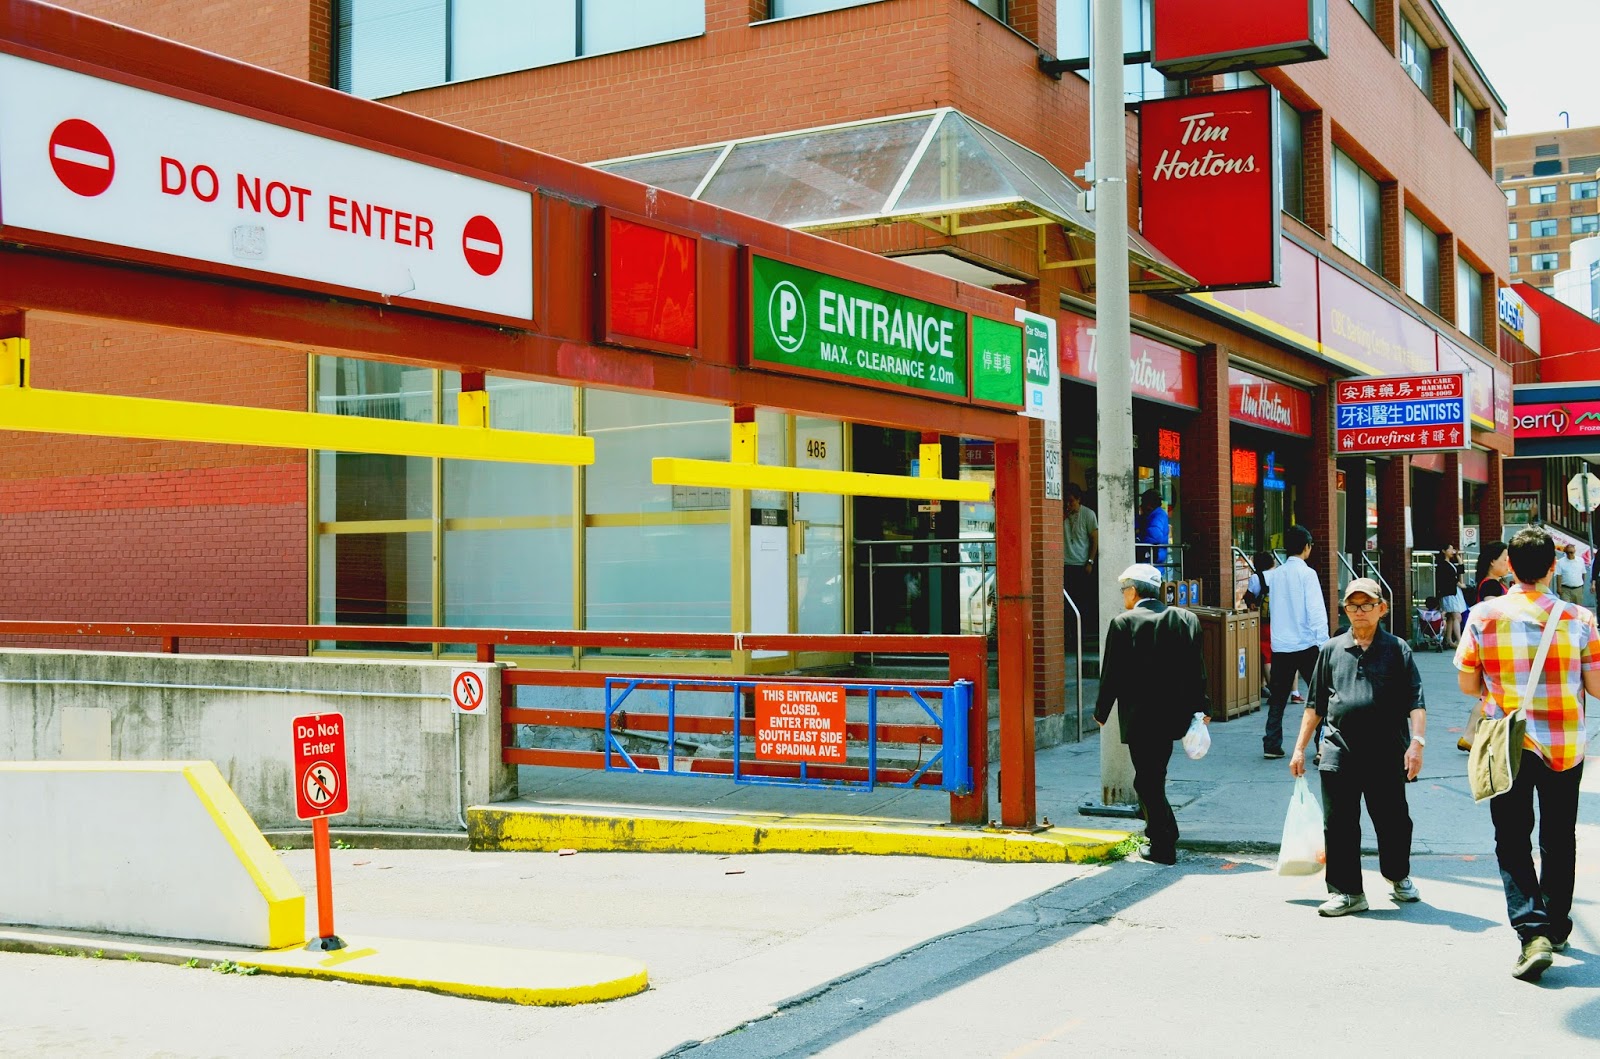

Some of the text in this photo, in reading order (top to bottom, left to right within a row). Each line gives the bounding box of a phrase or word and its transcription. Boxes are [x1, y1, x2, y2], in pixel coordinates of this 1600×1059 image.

[1179, 112, 1231, 146] Tim
[1152, 149, 1256, 182] Hortons
[160, 156, 435, 251] DO NOT ENTER
[819, 289, 954, 358] ENTRANCE
[1025, 325, 1047, 339] Car Share
[820, 342, 954, 385] MAX. CLEARANCE 2.0m
[1130, 349, 1166, 393] ortons
[1342, 382, 1414, 400] 安康藥房
[1416, 383, 1456, 391] PHARMACY
[1239, 378, 1291, 427] Tim Hortons
[1341, 402, 1461, 426] 牙科醫生 DENTISTS
[1357, 430, 1416, 447] Carefirst
[806, 439, 827, 459] 485
[1045, 449, 1060, 465] POST
[1045, 465, 1055, 481] NO
[1046, 481, 1061, 497] BILLS
[762, 689, 838, 703] THIS ENTRANCE
[780, 703, 820, 716] CLOSED.
[297, 722, 339, 739] Do Not
[769, 716, 831, 729] ENTER FROM
[758, 729, 843, 744] SOUTH EAST SIDE
[302, 741, 336, 757] Enter
[760, 743, 841, 757] OF SPADINA AVE.
